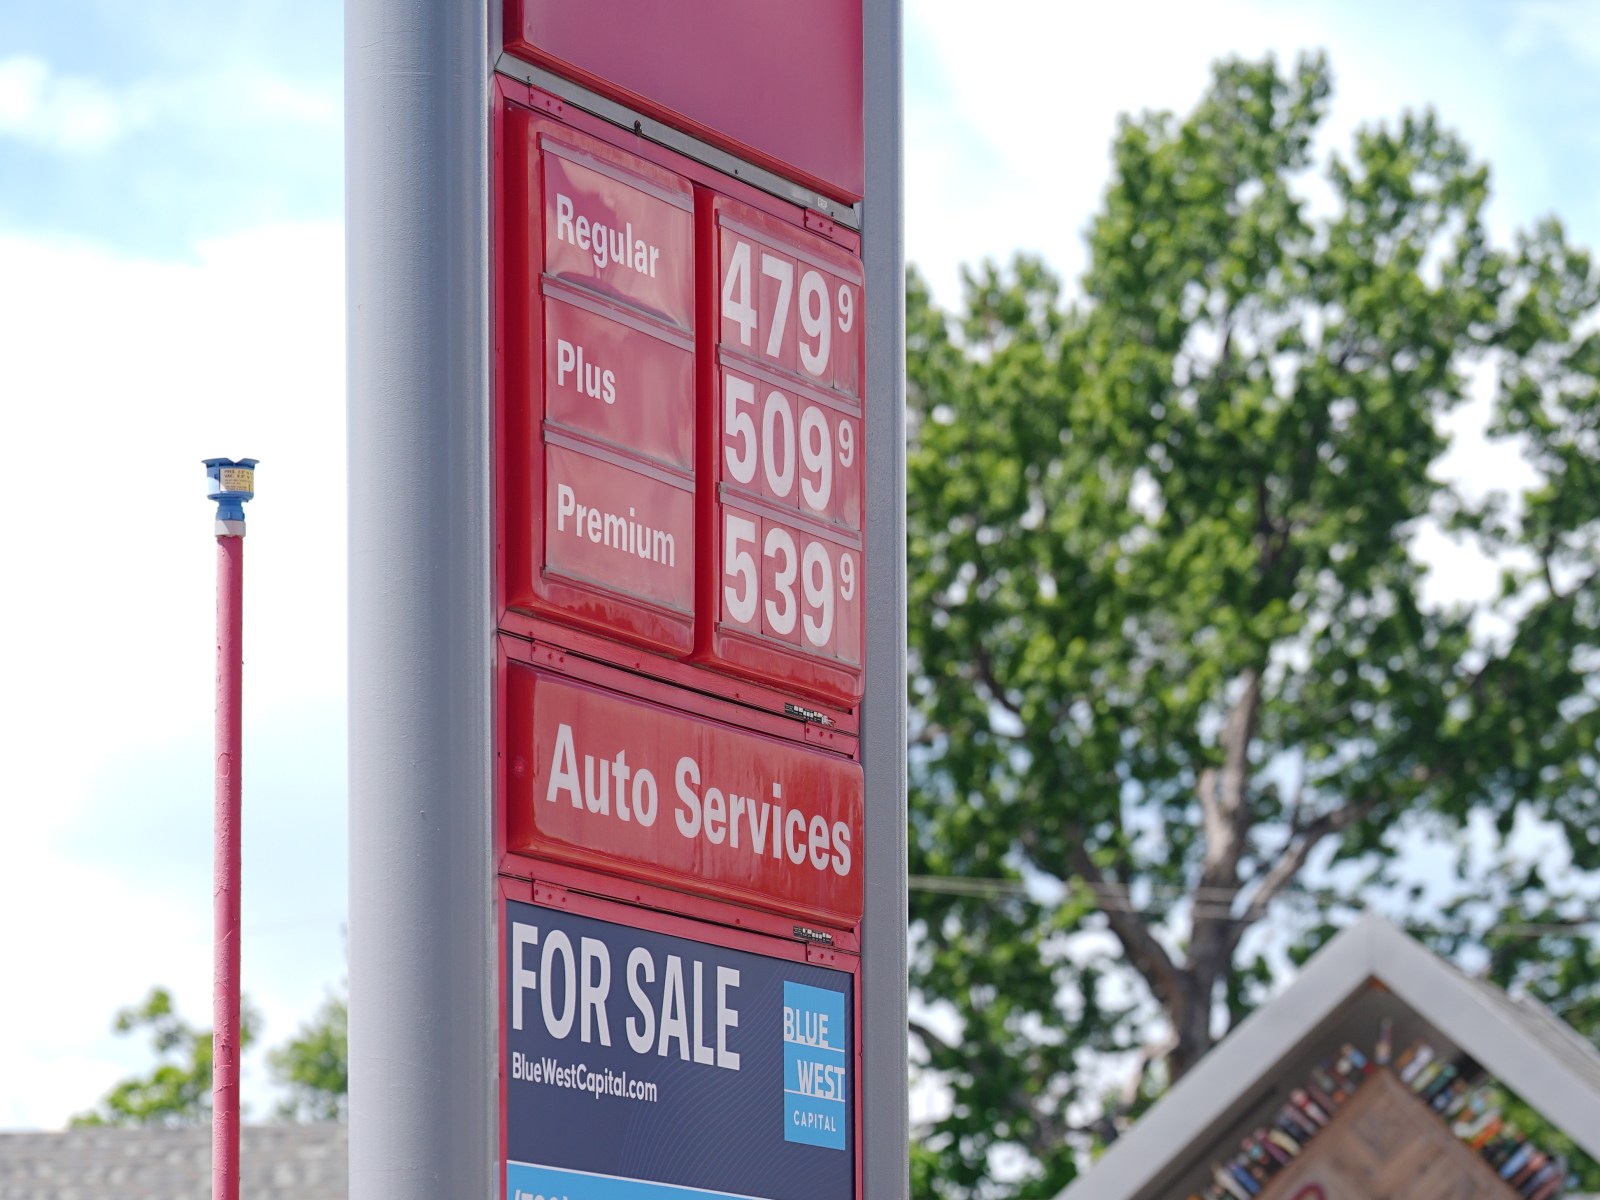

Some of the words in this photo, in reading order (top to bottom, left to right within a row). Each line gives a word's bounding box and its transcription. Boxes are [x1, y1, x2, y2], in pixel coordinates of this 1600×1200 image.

[558, 193, 659, 279] Regular
[557, 338, 616, 405] Plus
[557, 483, 675, 568] Premium
[547, 723, 658, 827] Auto
[675, 756, 852, 876] Services
[513, 922, 611, 1047] FOR
[625, 947, 740, 1071] SALE
[784, 1006, 829, 1048] BLUE
[513, 1052, 657, 1102] BlueWestCapital.com
[797, 1059, 845, 1101] WEST
[793, 1109, 837, 1132] CAPITAL
